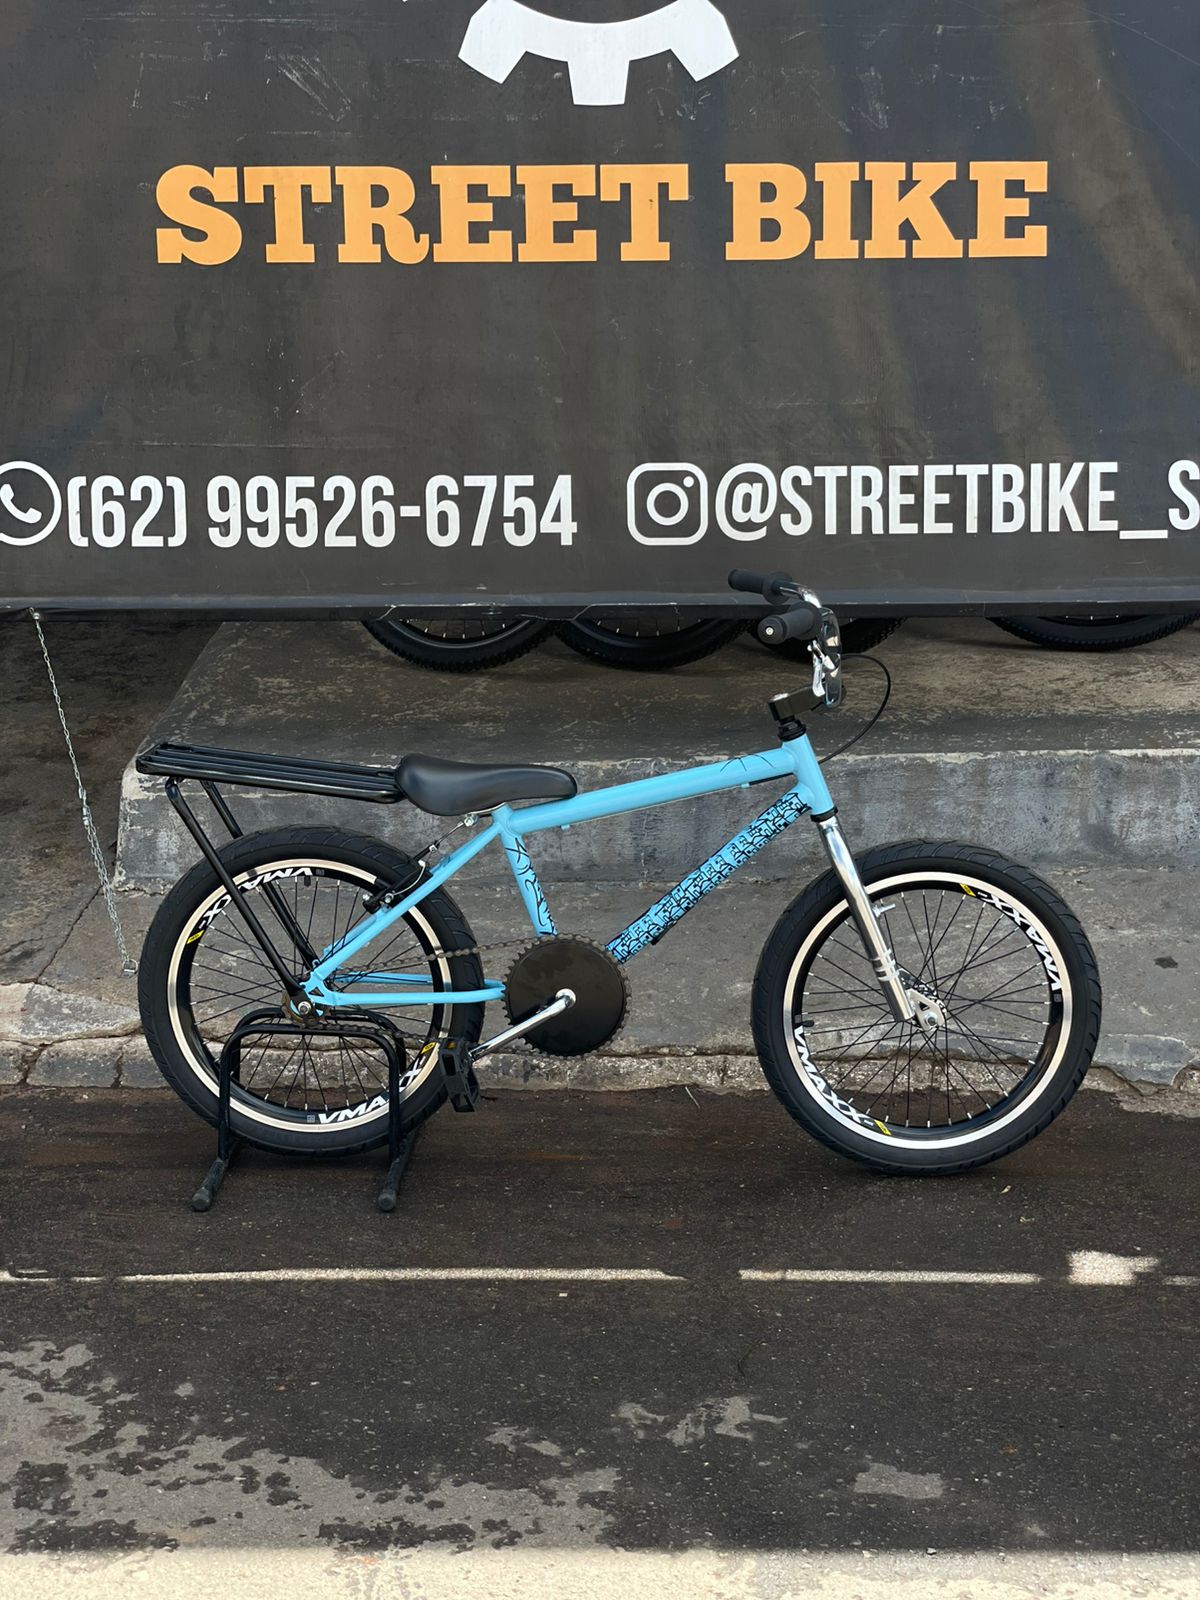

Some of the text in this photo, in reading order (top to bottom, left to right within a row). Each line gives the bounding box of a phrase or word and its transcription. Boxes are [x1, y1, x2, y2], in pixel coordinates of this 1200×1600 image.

[155, 160, 1049, 266] STREET BIKE
[67, 474, 578, 548] (62) 99526-6754
[715, 460, 1200, 542] @STREETBIKE_S
[981, 893, 1063, 991] VMAXX
[794, 1025, 871, 1124] VMAXX
